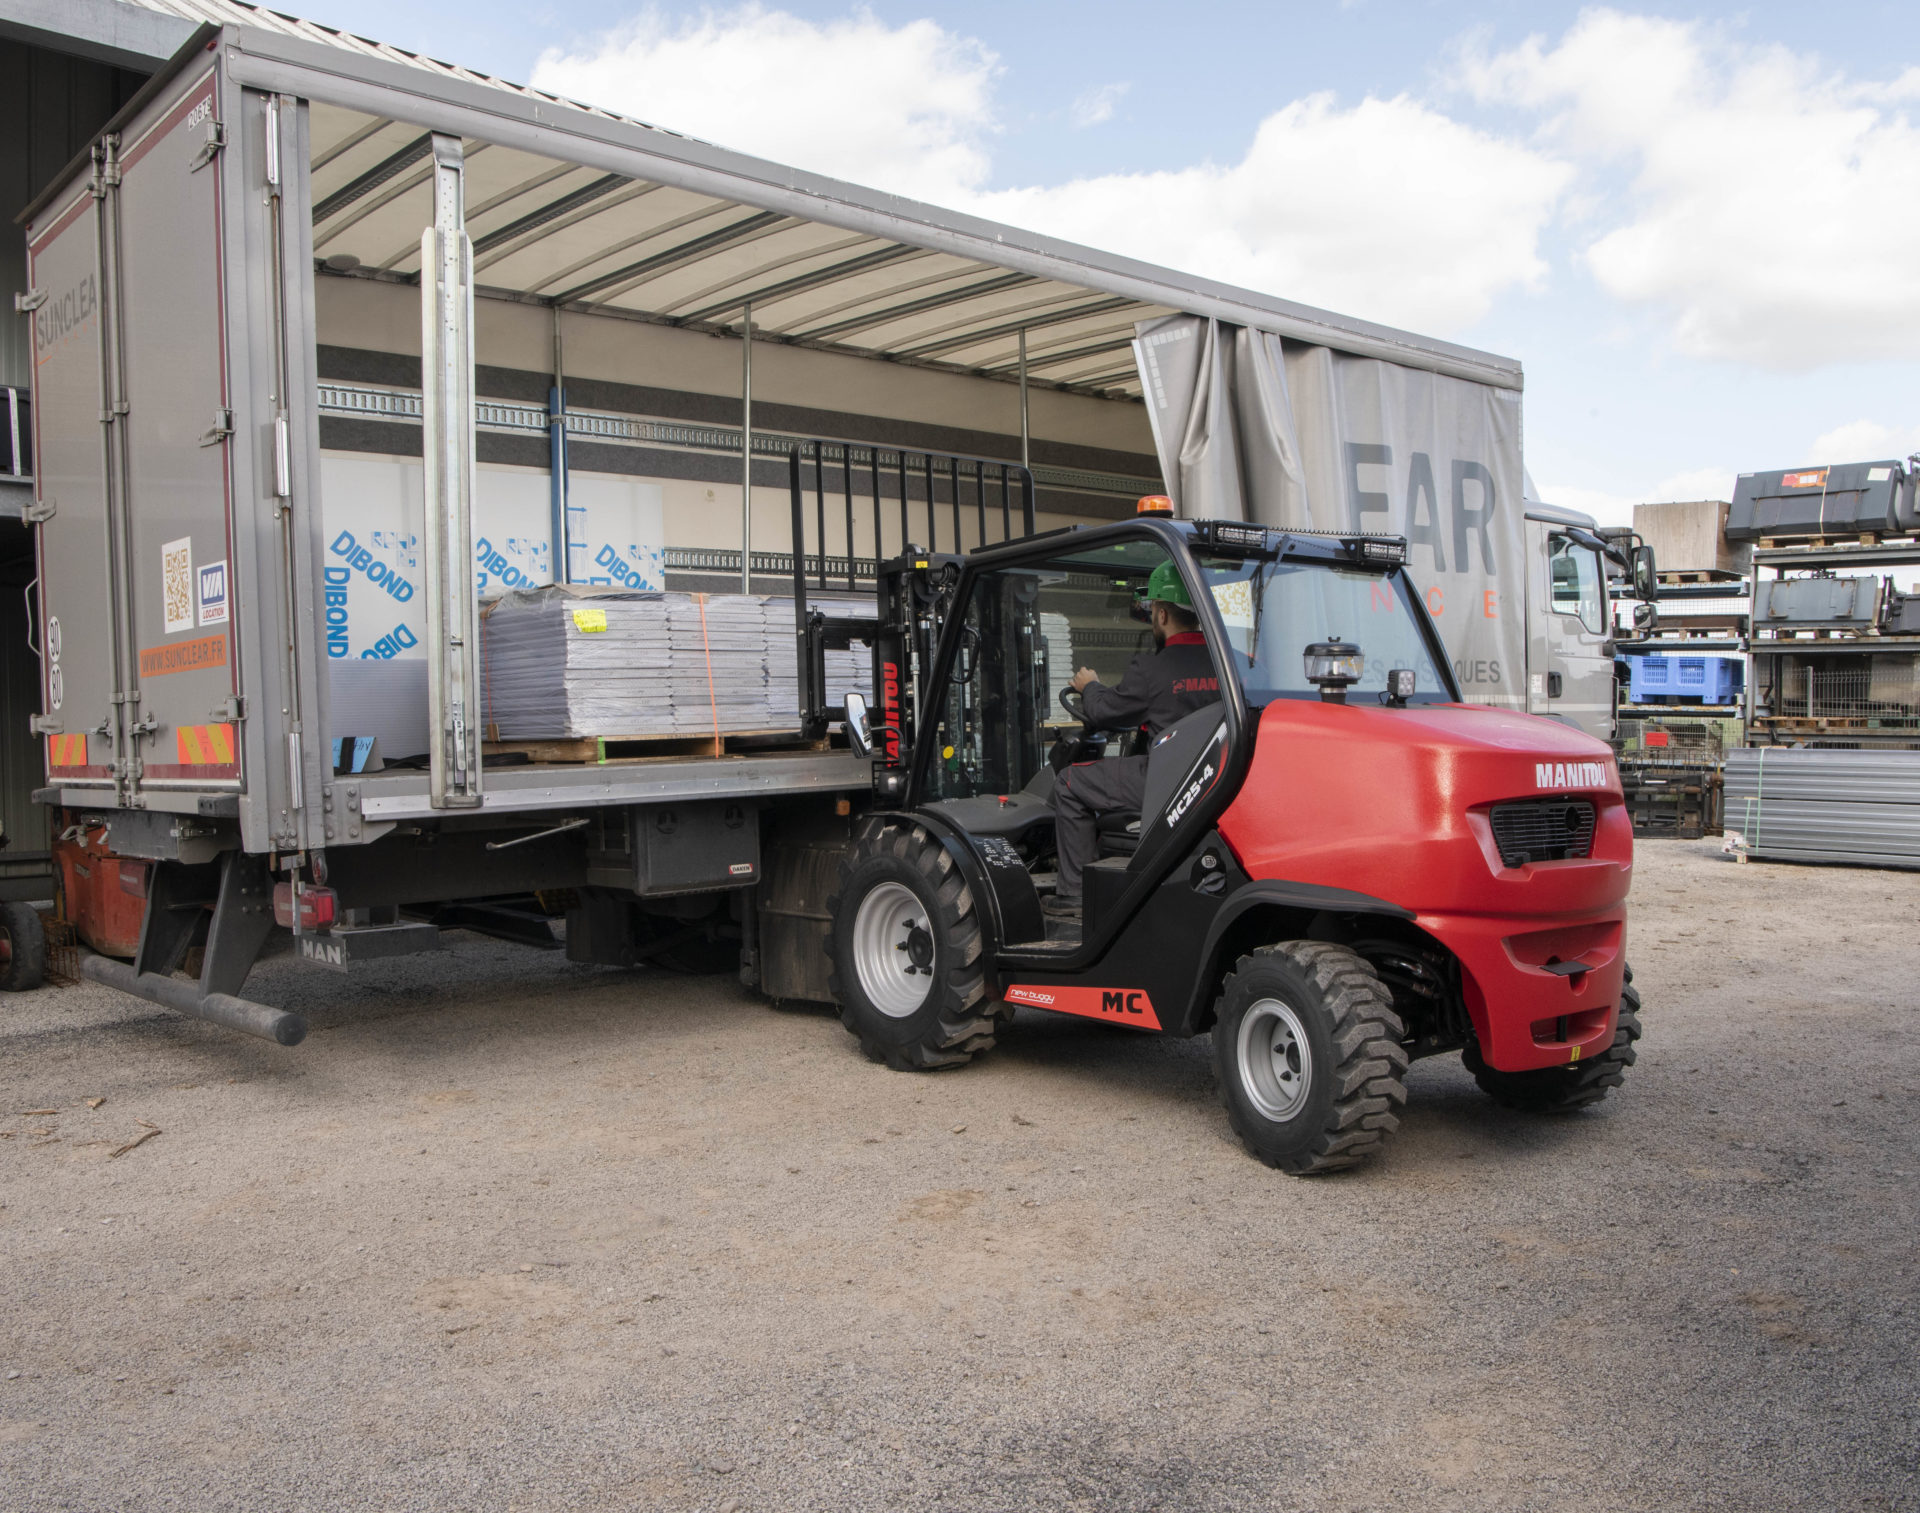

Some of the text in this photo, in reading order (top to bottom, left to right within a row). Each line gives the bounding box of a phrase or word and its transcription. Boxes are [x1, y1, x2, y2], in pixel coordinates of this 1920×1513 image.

[37, 273, 98, 351] SUNCLEA
[329, 529, 414, 603] DIBOND
[477, 537, 540, 590] DIBON
[202, 570, 223, 600] VIA
[202, 606, 225, 620] LOCATION
[324, 566, 351, 658] DIBOND
[50, 620, 60, 657] 90
[142, 639, 224, 673] WWW.SUNCLEAR.FR
[52, 668, 62, 705] 80
[1536, 762, 1607, 788] MANITOU
[1165, 763, 1214, 829] MC25-4
[303, 939, 341, 965] MAN
[1010, 988, 1056, 1003] new buggy
[1102, 991, 1143, 1014] MC
